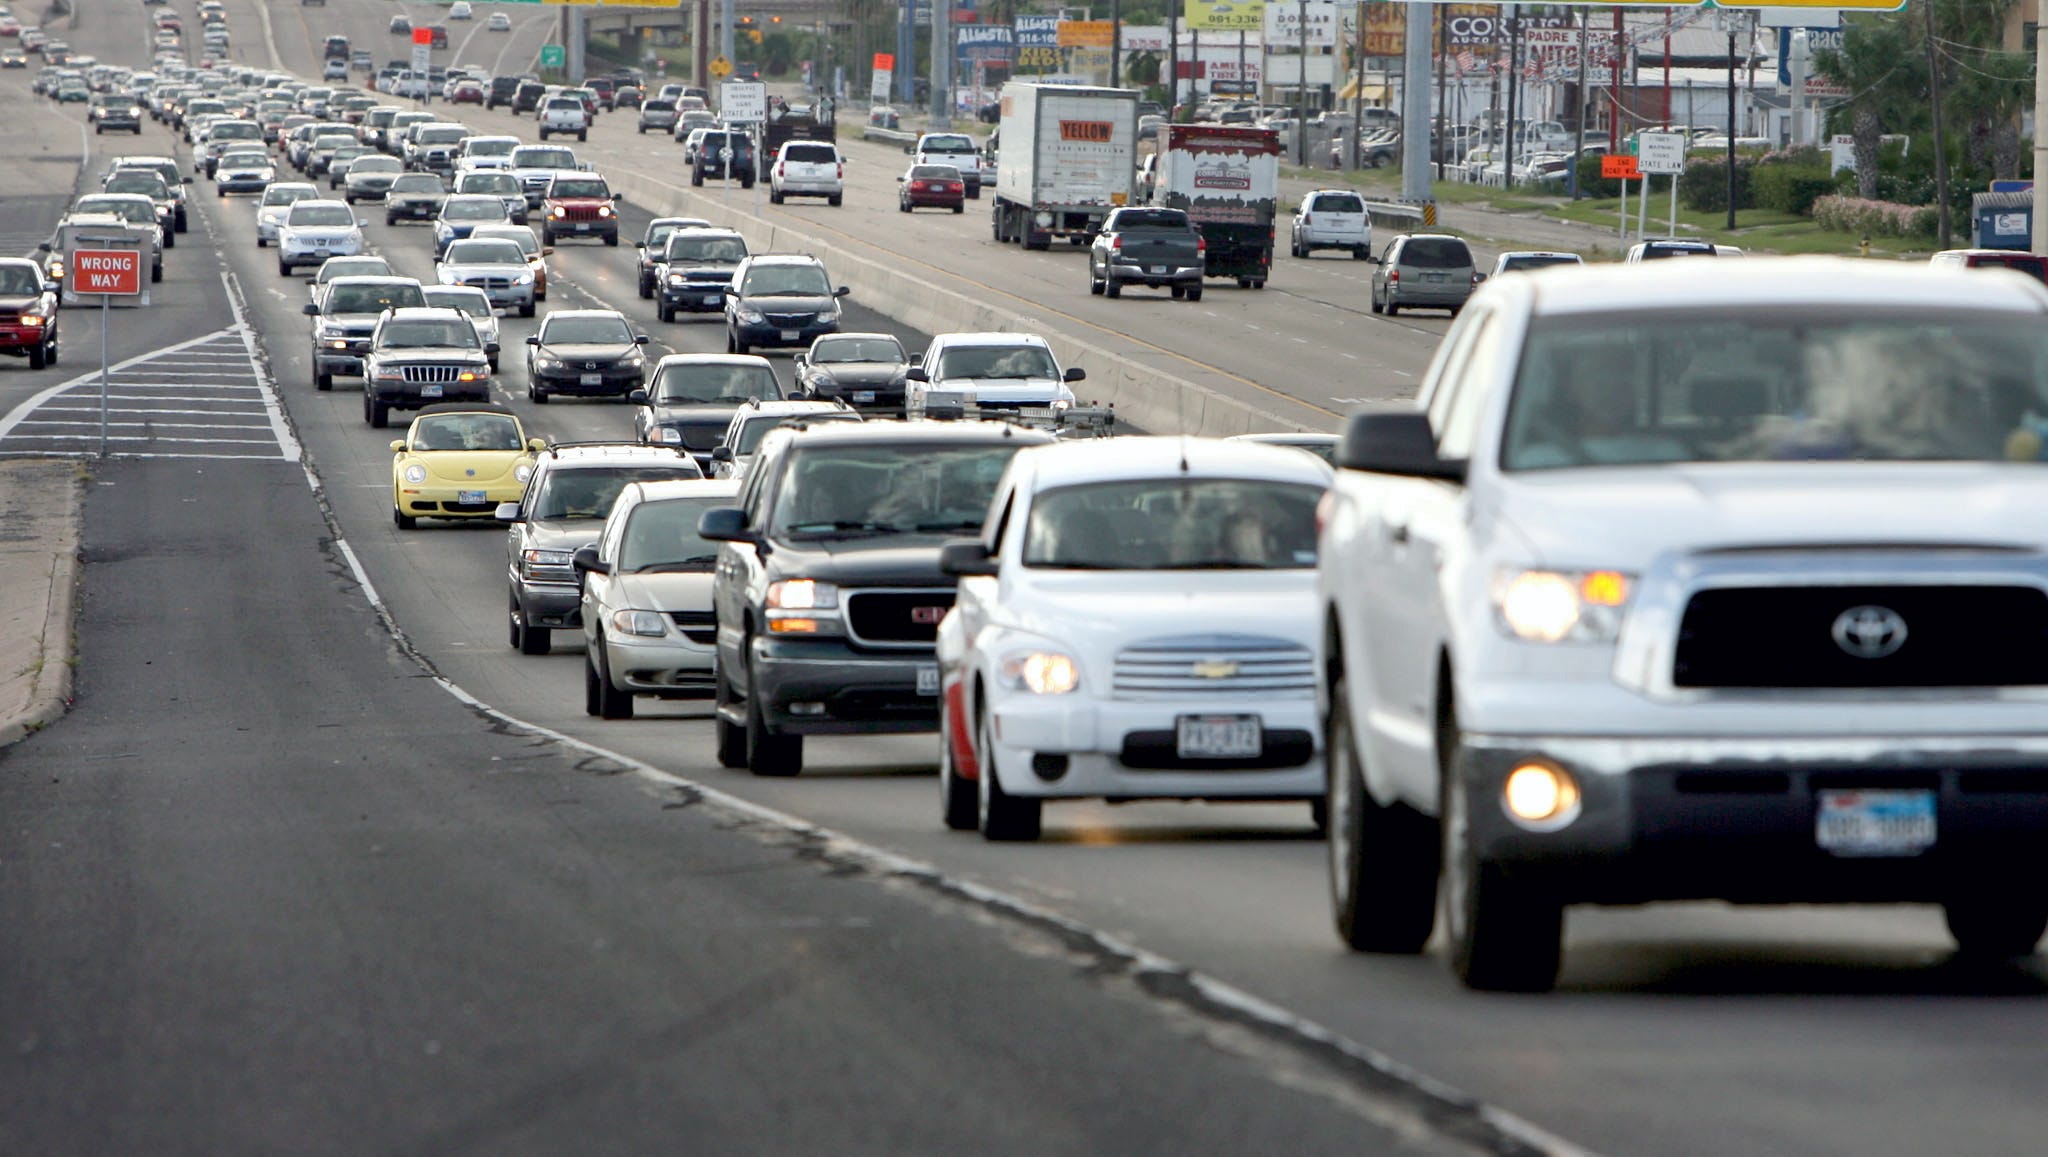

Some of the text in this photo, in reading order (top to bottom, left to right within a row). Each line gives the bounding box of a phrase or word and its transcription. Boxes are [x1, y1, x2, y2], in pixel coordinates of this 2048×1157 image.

[958, 27, 1013, 45] ALLSTA
[1528, 31, 1569, 42] PADRE
[1020, 47, 1062, 57] KIDS
[1062, 122, 1110, 140] YELLOW
[1640, 160, 1682, 169] STATE LAW
[81, 257, 132, 271] WRONG
[91, 274, 121, 287] WAY
